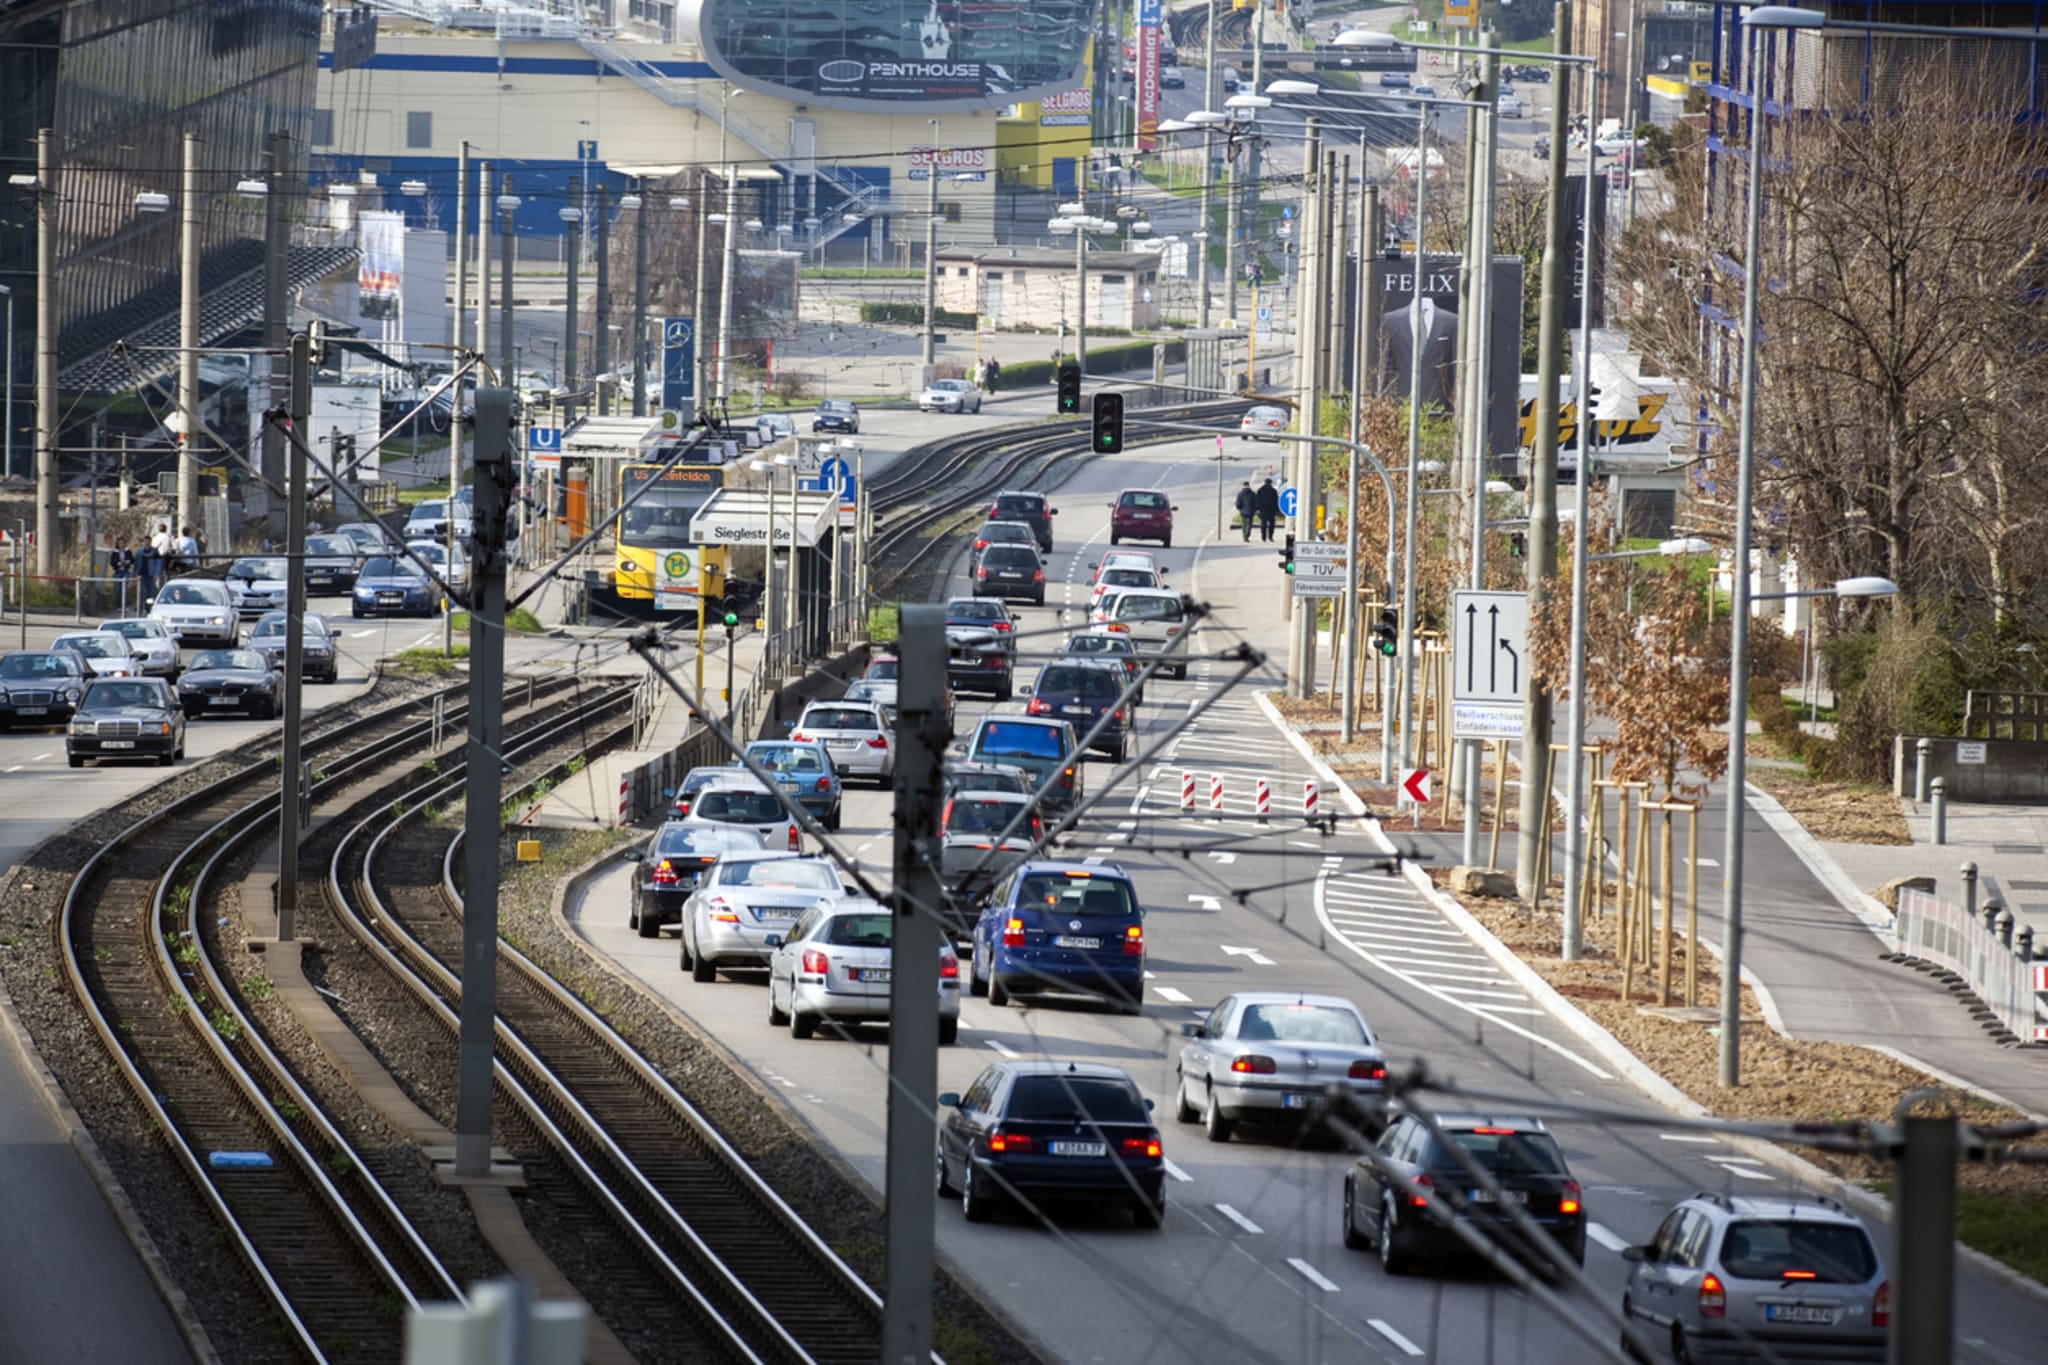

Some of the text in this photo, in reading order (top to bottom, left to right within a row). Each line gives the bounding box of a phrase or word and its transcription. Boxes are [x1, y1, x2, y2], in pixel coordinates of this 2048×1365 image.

[869, 63, 980, 77] PENTHOUSE
[1143, 26, 1157, 113] McDonald's
[1041, 89, 1090, 111] SELGROS
[1384, 273, 1454, 292] FEIX
[536, 429, 553, 447] U
[660, 471, 711, 482] einfelden
[714, 526, 790, 541] Sieglestrße
[1499, 722, 1522, 733] lasse
